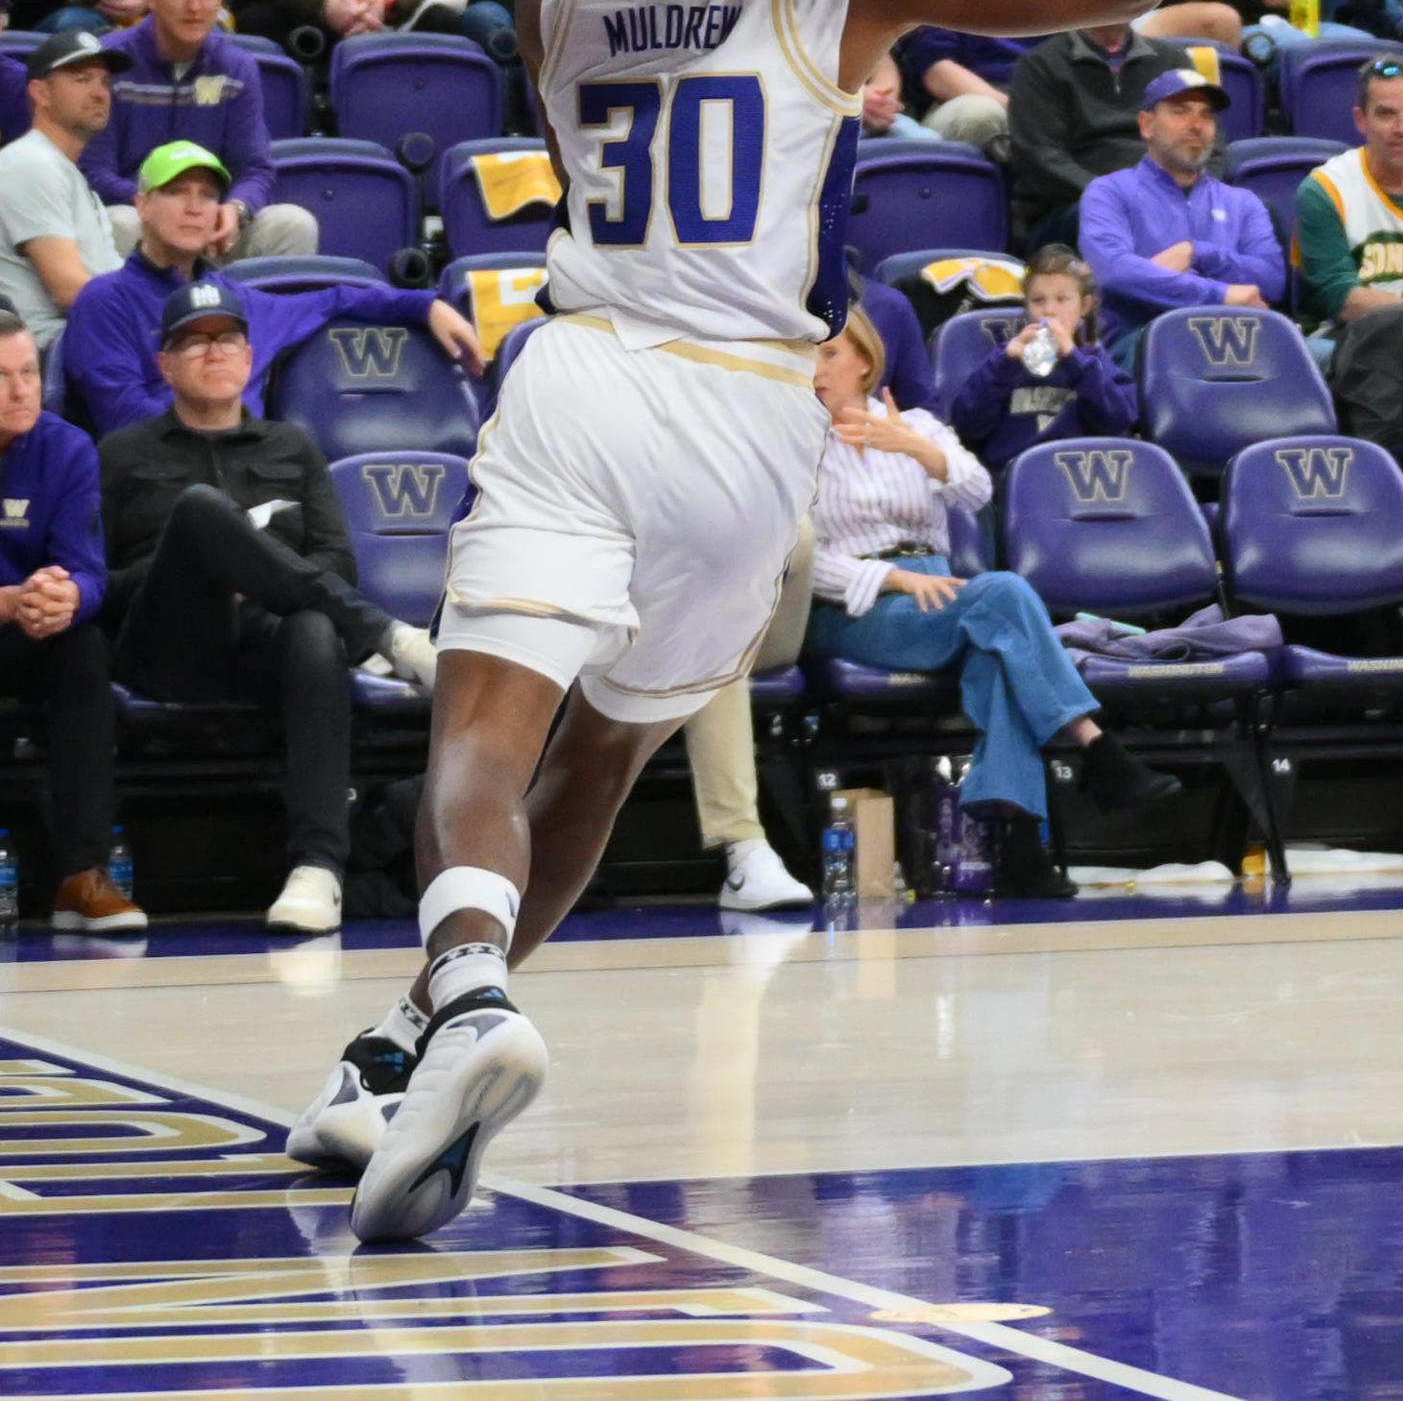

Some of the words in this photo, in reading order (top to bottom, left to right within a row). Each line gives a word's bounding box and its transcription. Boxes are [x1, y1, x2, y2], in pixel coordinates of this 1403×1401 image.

[603, 5, 742, 57] MULDREW
[579, 73, 766, 248] 30
[329, 327, 409, 379] W
[1187, 316, 1261, 366] W
[363, 464, 445, 517] W
[1055, 450, 1134, 503] W
[1276, 447, 1353, 498] W
[817, 772, 837, 788] 12
[1055, 766, 1073, 780] 13
[1272, 758, 1291, 773] 14
